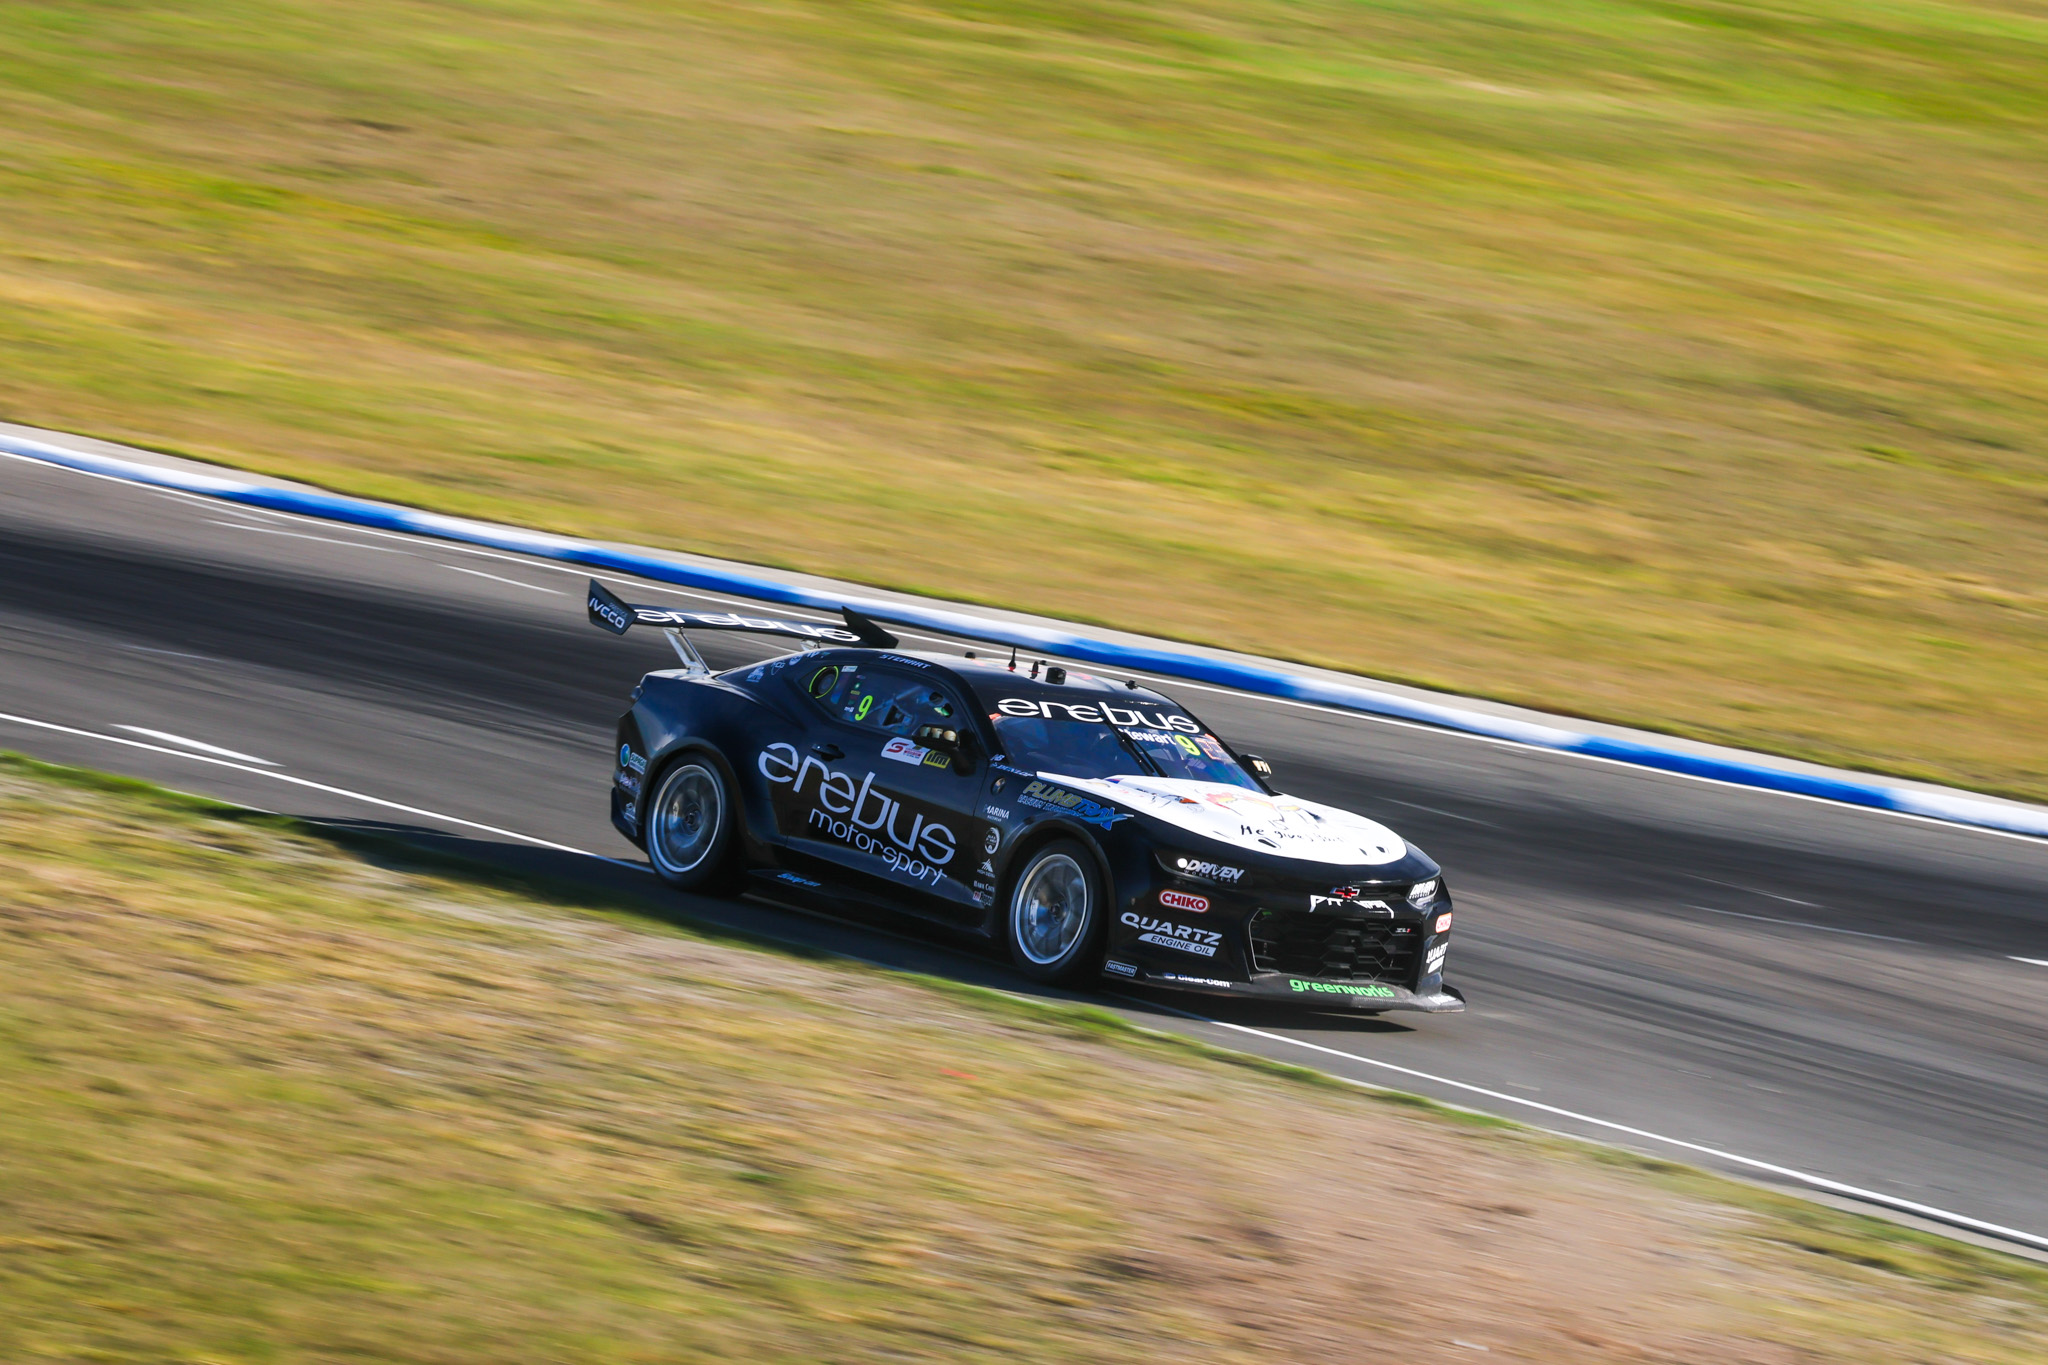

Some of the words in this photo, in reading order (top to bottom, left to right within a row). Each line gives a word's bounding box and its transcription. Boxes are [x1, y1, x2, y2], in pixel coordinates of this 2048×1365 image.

[589, 597, 626, 629] IVCCO
[635, 608, 861, 642] erebus
[855, 695, 873, 721] 9
[998, 698, 1200, 734] erebus
[1174, 734, 1201, 757] 9
[758, 743, 957, 865] erebus
[808, 808, 948, 887] motorsport
[1185, 859, 1246, 880] DRIVEN
[1162, 892, 1206, 910] CHIKO
[1120, 912, 1223, 946] QUARTZ
[1150, 935, 1192, 951] ENGINE
[1194, 945, 1212, 956] OIL
[1289, 979, 1395, 998] greenworks
